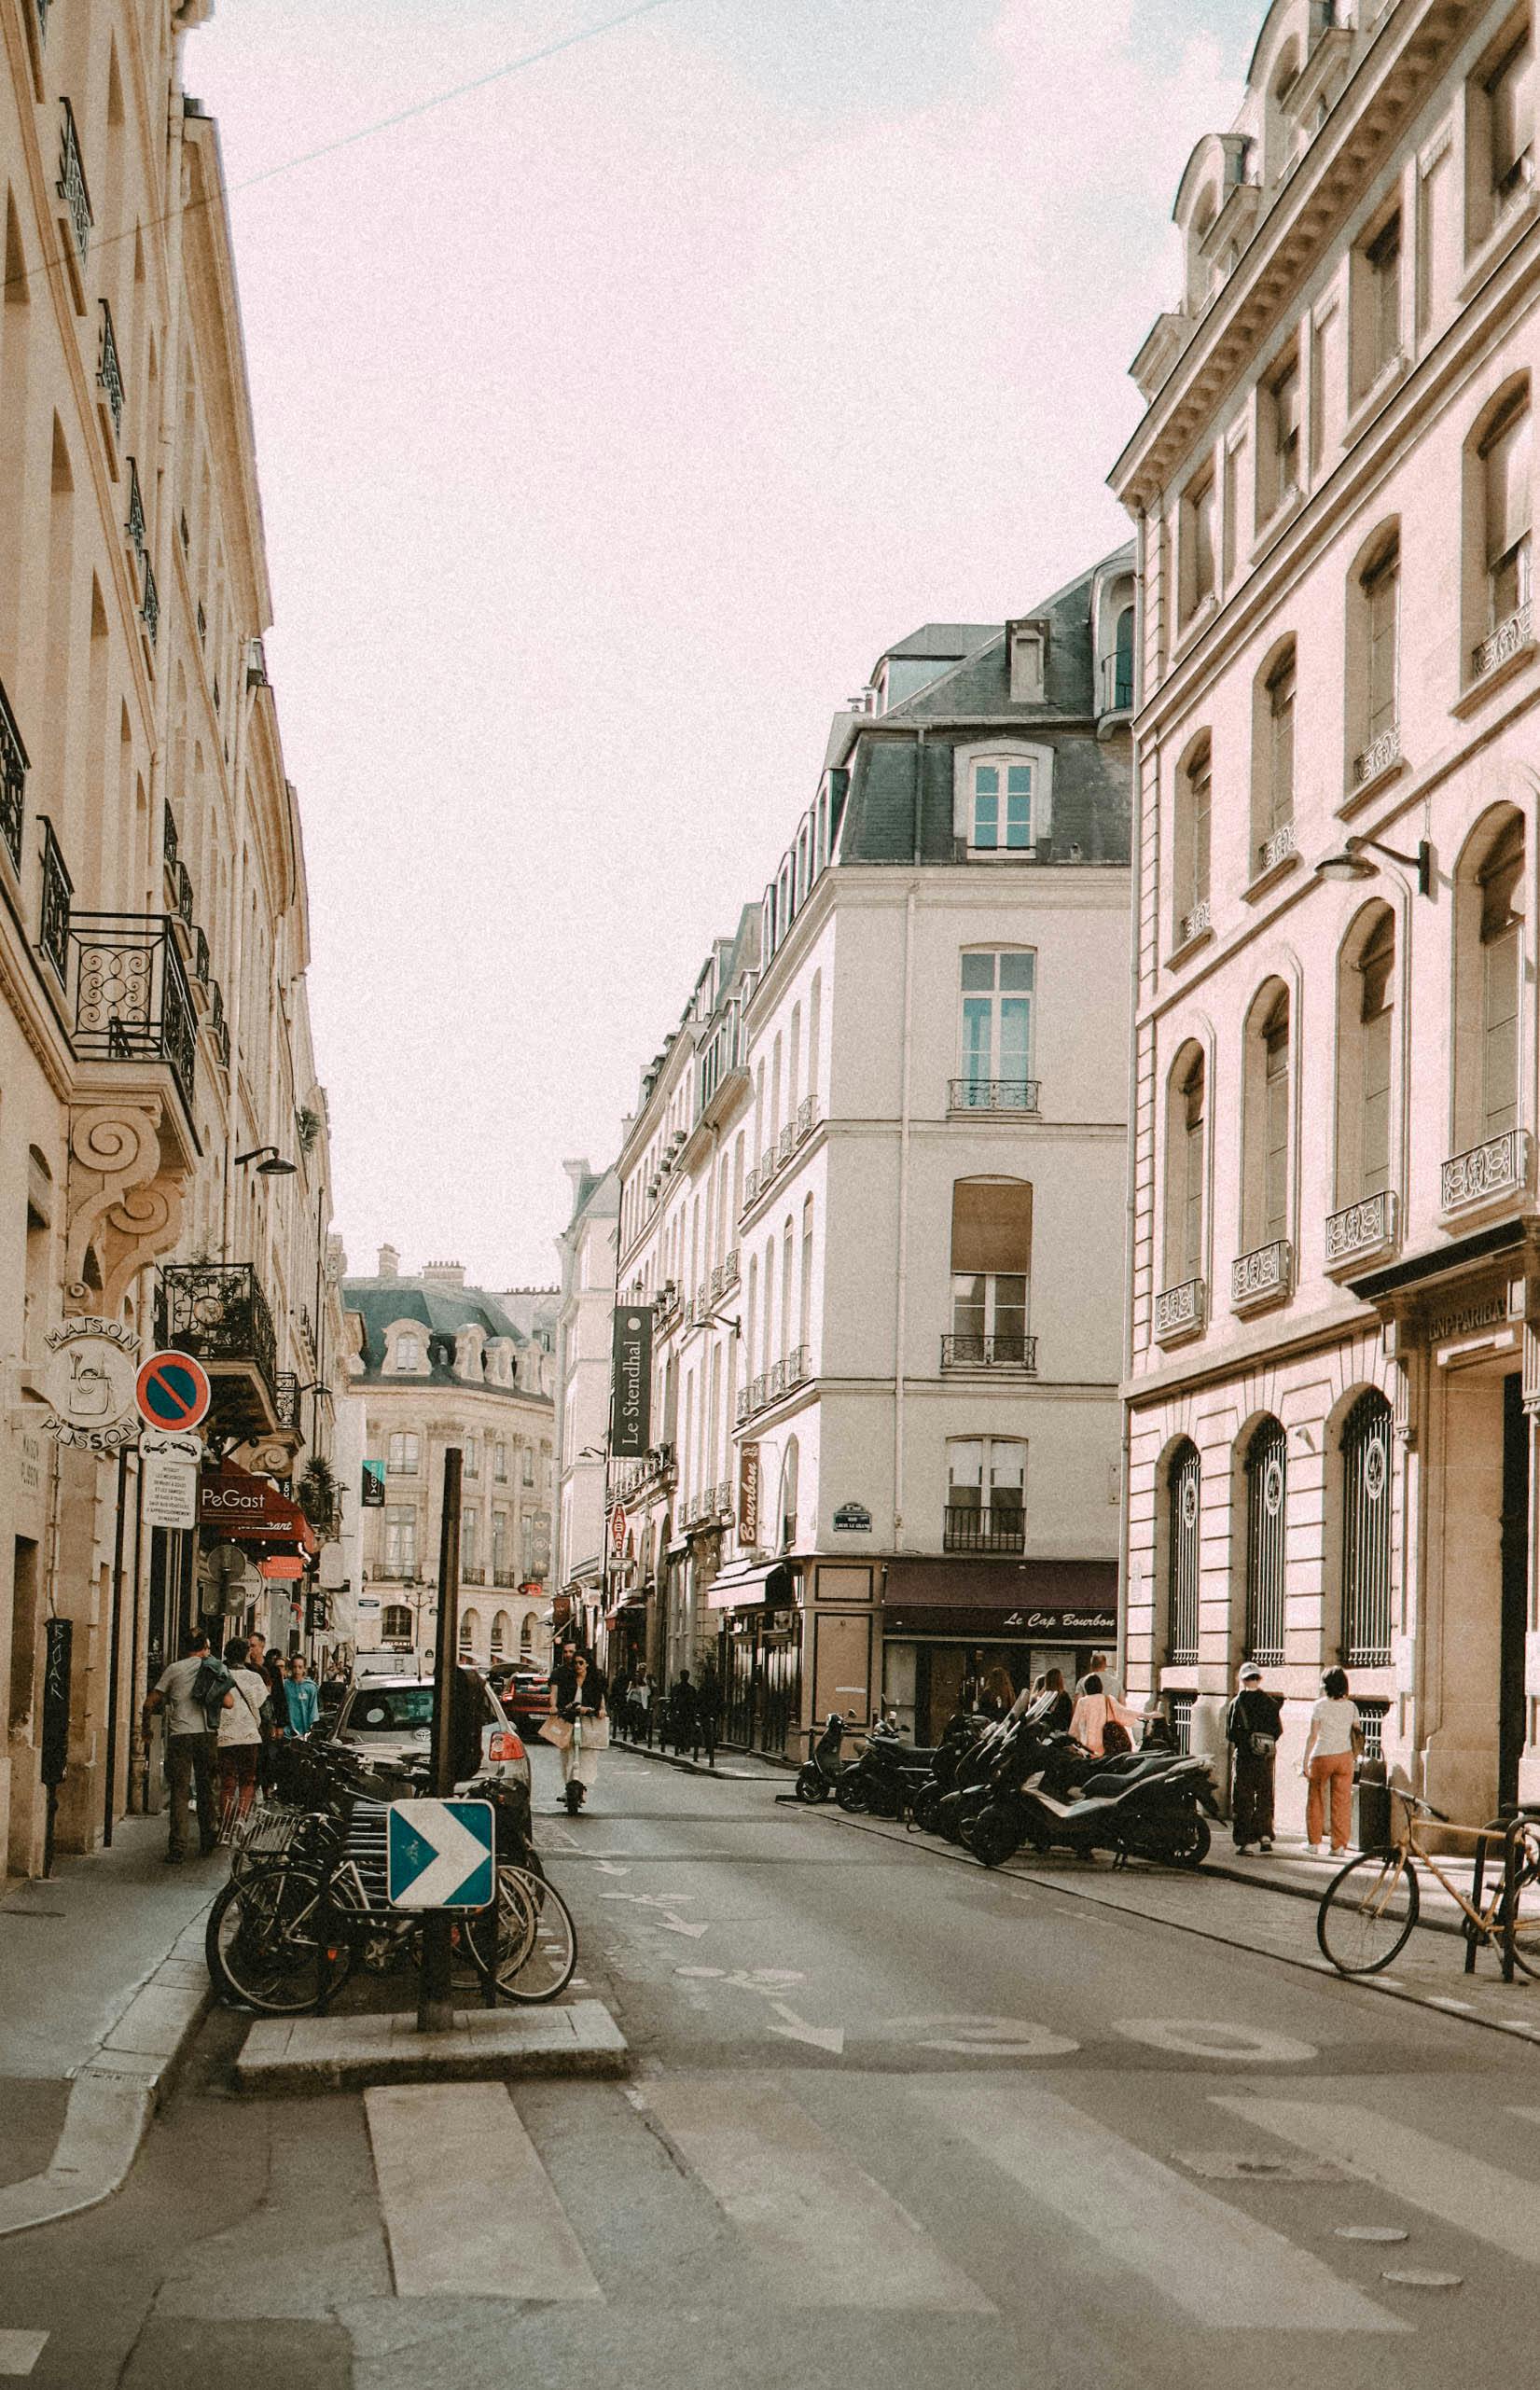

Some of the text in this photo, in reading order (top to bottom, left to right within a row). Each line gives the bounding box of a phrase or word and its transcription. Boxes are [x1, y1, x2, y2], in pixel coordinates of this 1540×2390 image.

[44, 1316, 142, 1353] MAISON
[621, 1341, 641, 1445] Le Stendhal
[40, 1414, 142, 1451] PLISSON
[201, 1489, 266, 1508] PeGast
[740, 1462, 757, 1542] Bourbon
[613, 1505, 625, 1549] TABAC
[1003, 1612, 1115, 1628] Le Cap Bourbon
[879, 2013, 1320, 2061] 30
